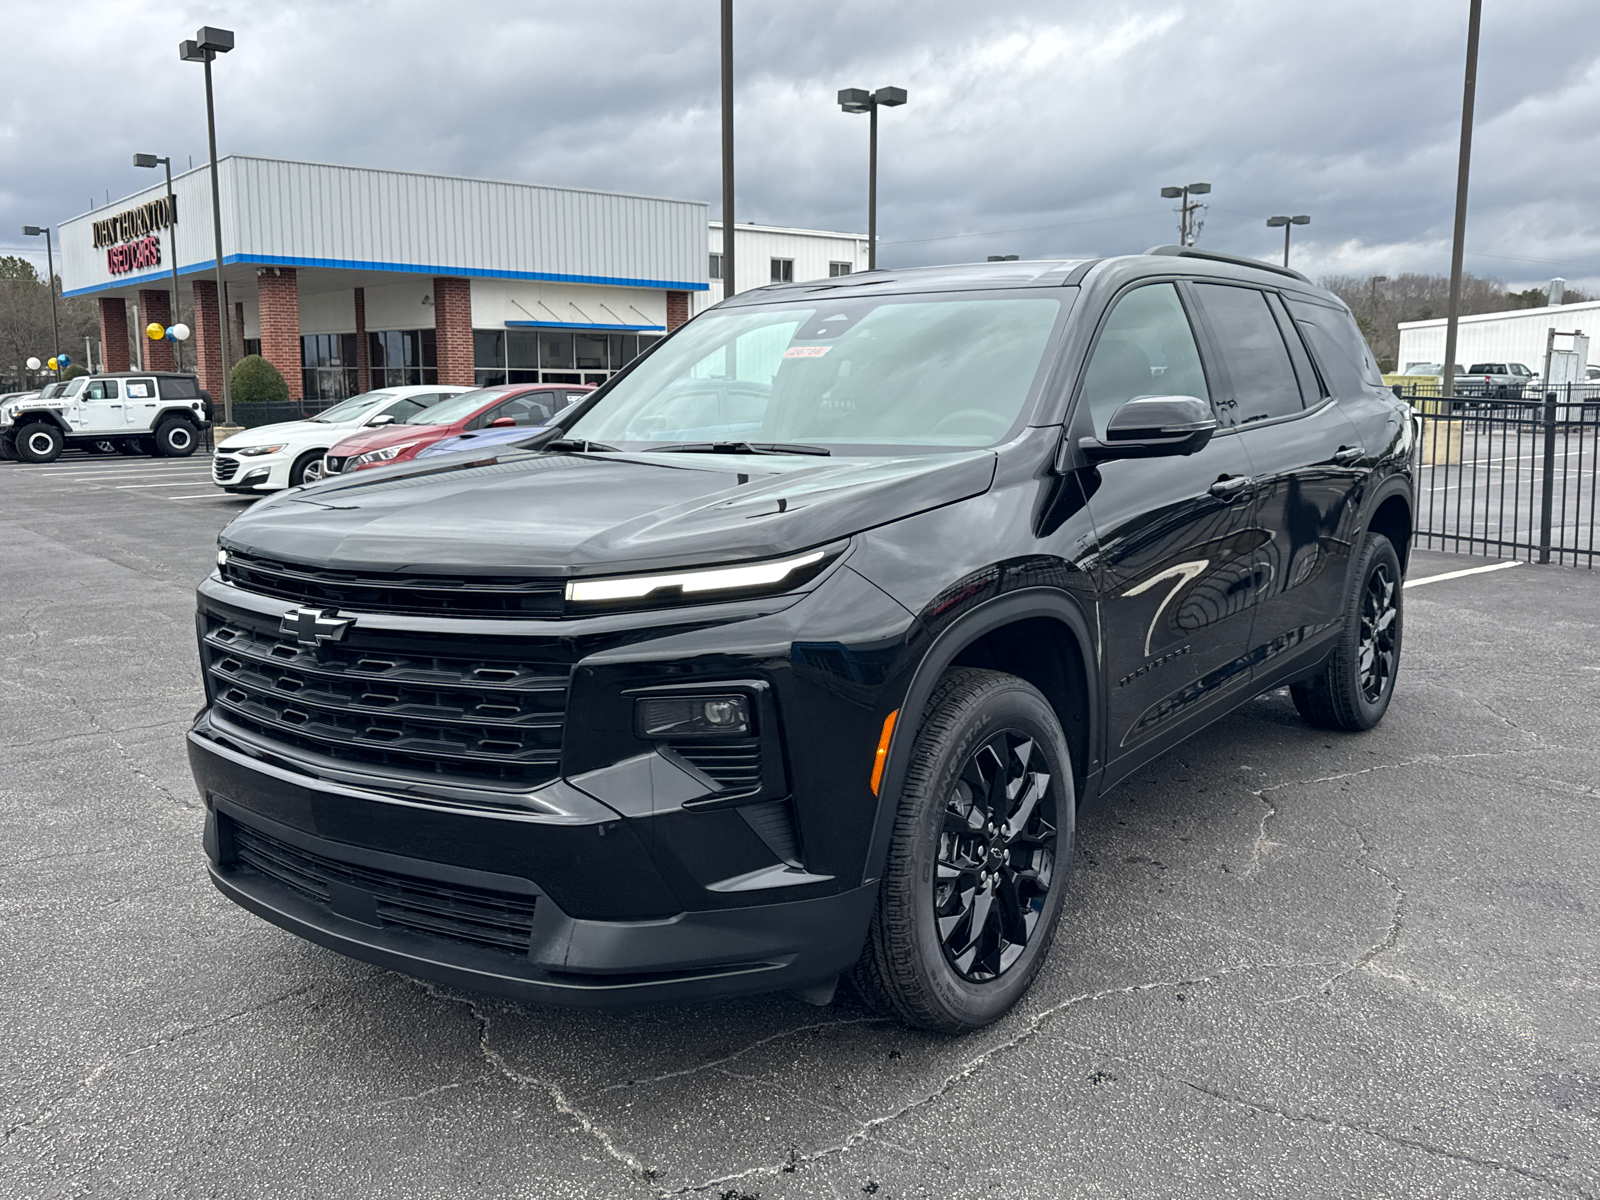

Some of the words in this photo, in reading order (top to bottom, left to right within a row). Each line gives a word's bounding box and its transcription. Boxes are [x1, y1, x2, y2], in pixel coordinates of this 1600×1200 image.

[92, 217, 118, 249] JOHN
[107, 244, 131, 274] USED
[131, 236, 159, 268] CARS
